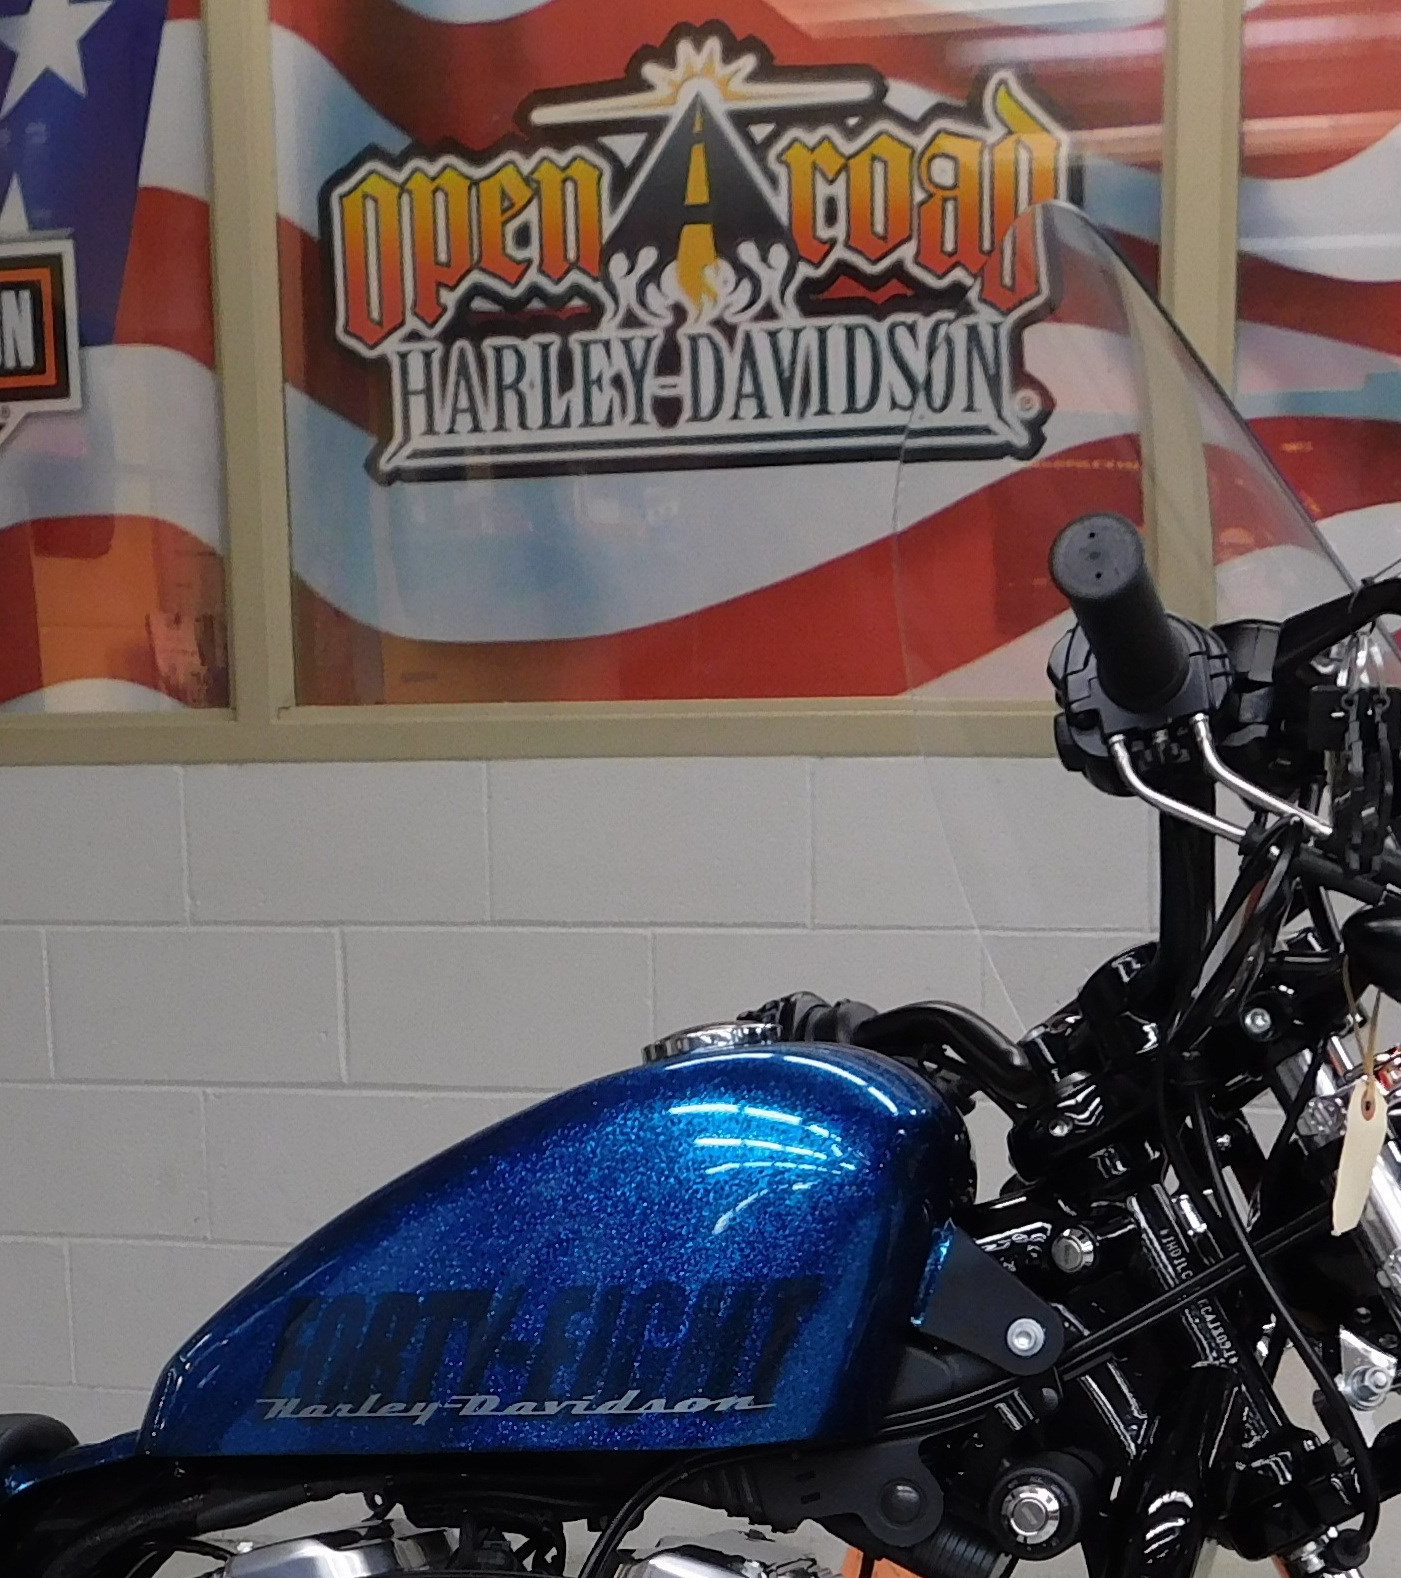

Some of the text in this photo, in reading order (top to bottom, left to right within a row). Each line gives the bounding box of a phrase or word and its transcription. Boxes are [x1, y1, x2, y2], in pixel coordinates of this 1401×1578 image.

[341, 78, 1062, 337] open road
[396, 319, 1006, 440] HARLEY-DAVIDSON
[255, 1391, 778, 1425] Harley-Davidson
